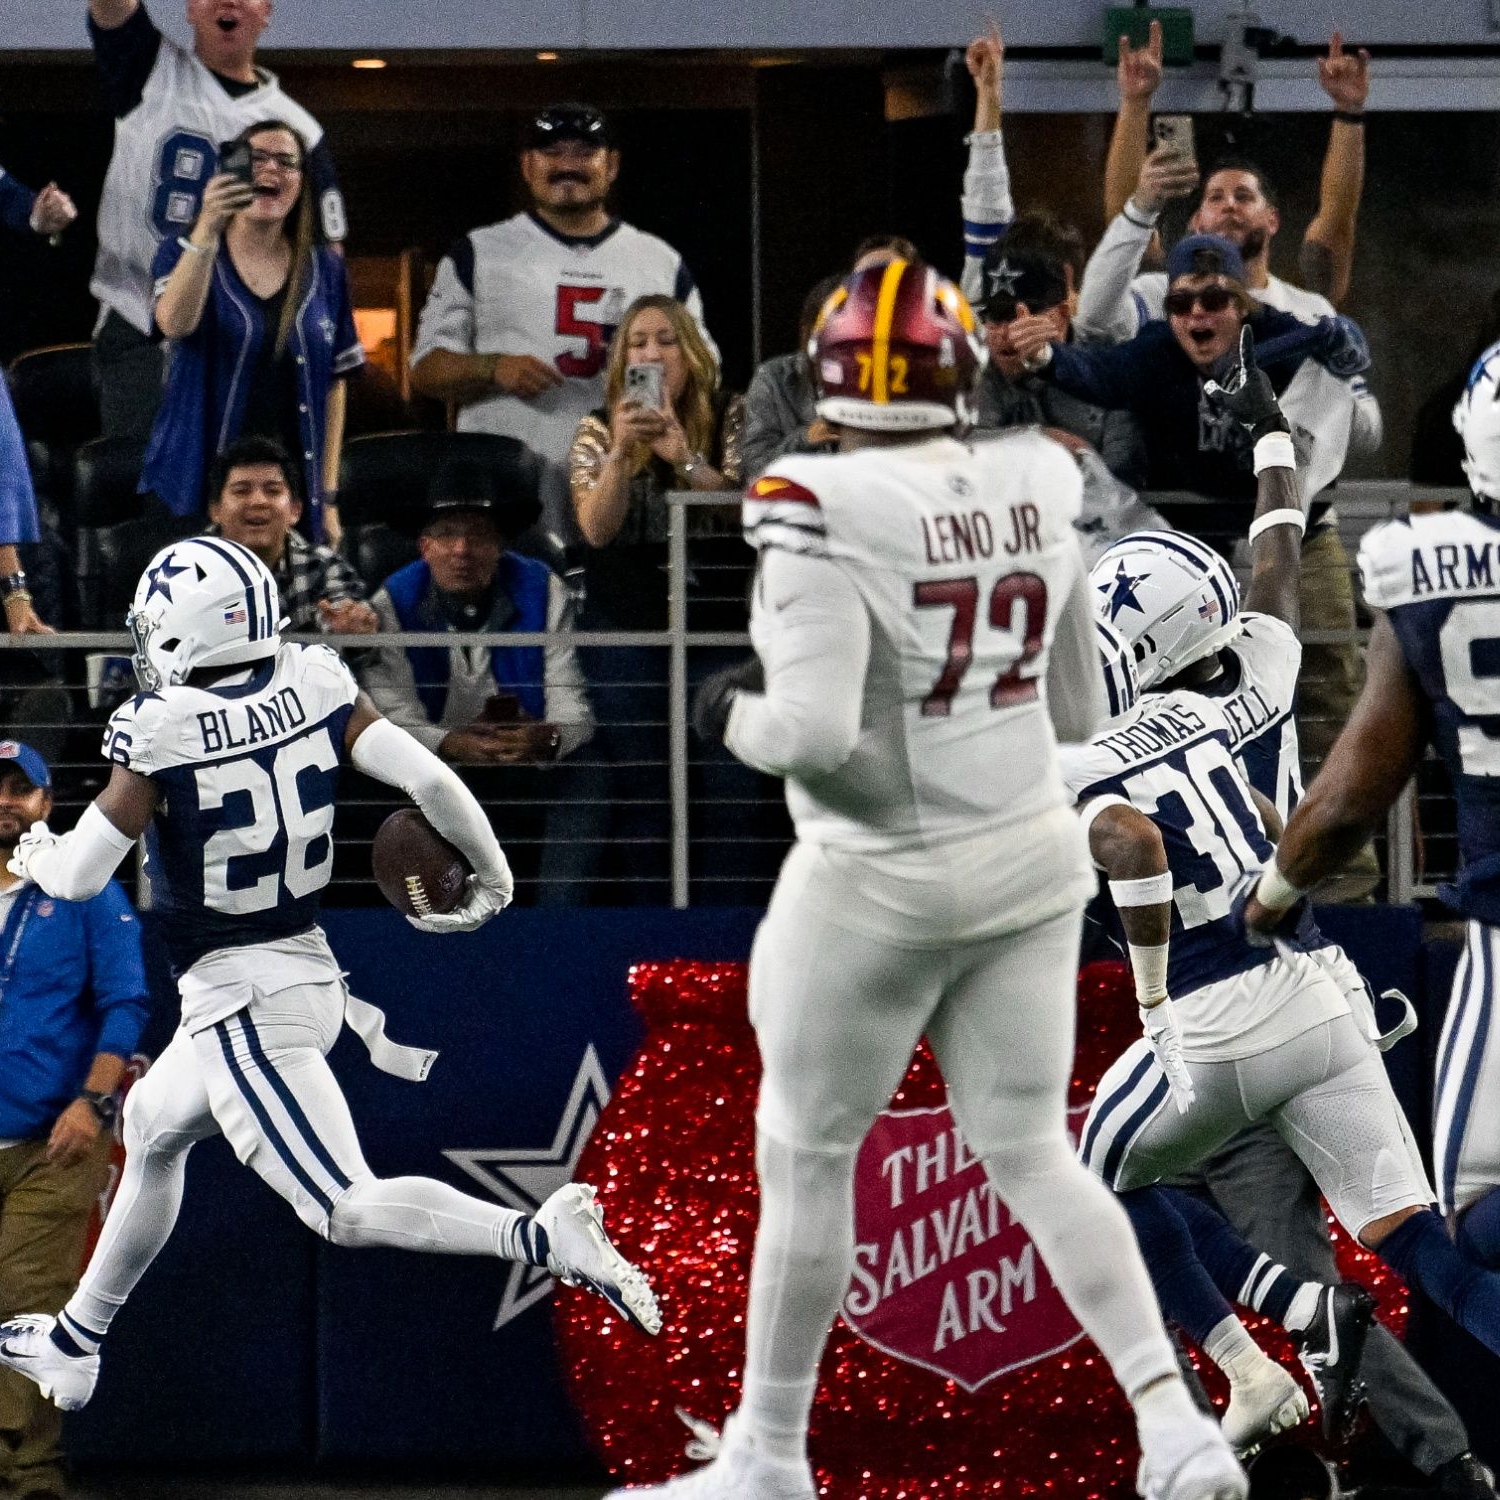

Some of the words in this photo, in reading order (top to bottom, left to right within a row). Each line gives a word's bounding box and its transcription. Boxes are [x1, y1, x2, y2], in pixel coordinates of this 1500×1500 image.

[149, 126, 222, 242] 8
[855, 351, 909, 394] 72
[920, 509, 995, 566] LENO
[1003, 502, 1042, 555] JR
[1411, 542, 1500, 595] ARM
[912, 571, 1049, 717] 72
[197, 686, 306, 754] BLAND
[1092, 703, 1206, 765] THOMAS
[194, 727, 341, 914] 26
[1121, 738, 1278, 930] 30
[843, 1182, 1010, 1316] SALVAT
[933, 1241, 1038, 1354] ARM
